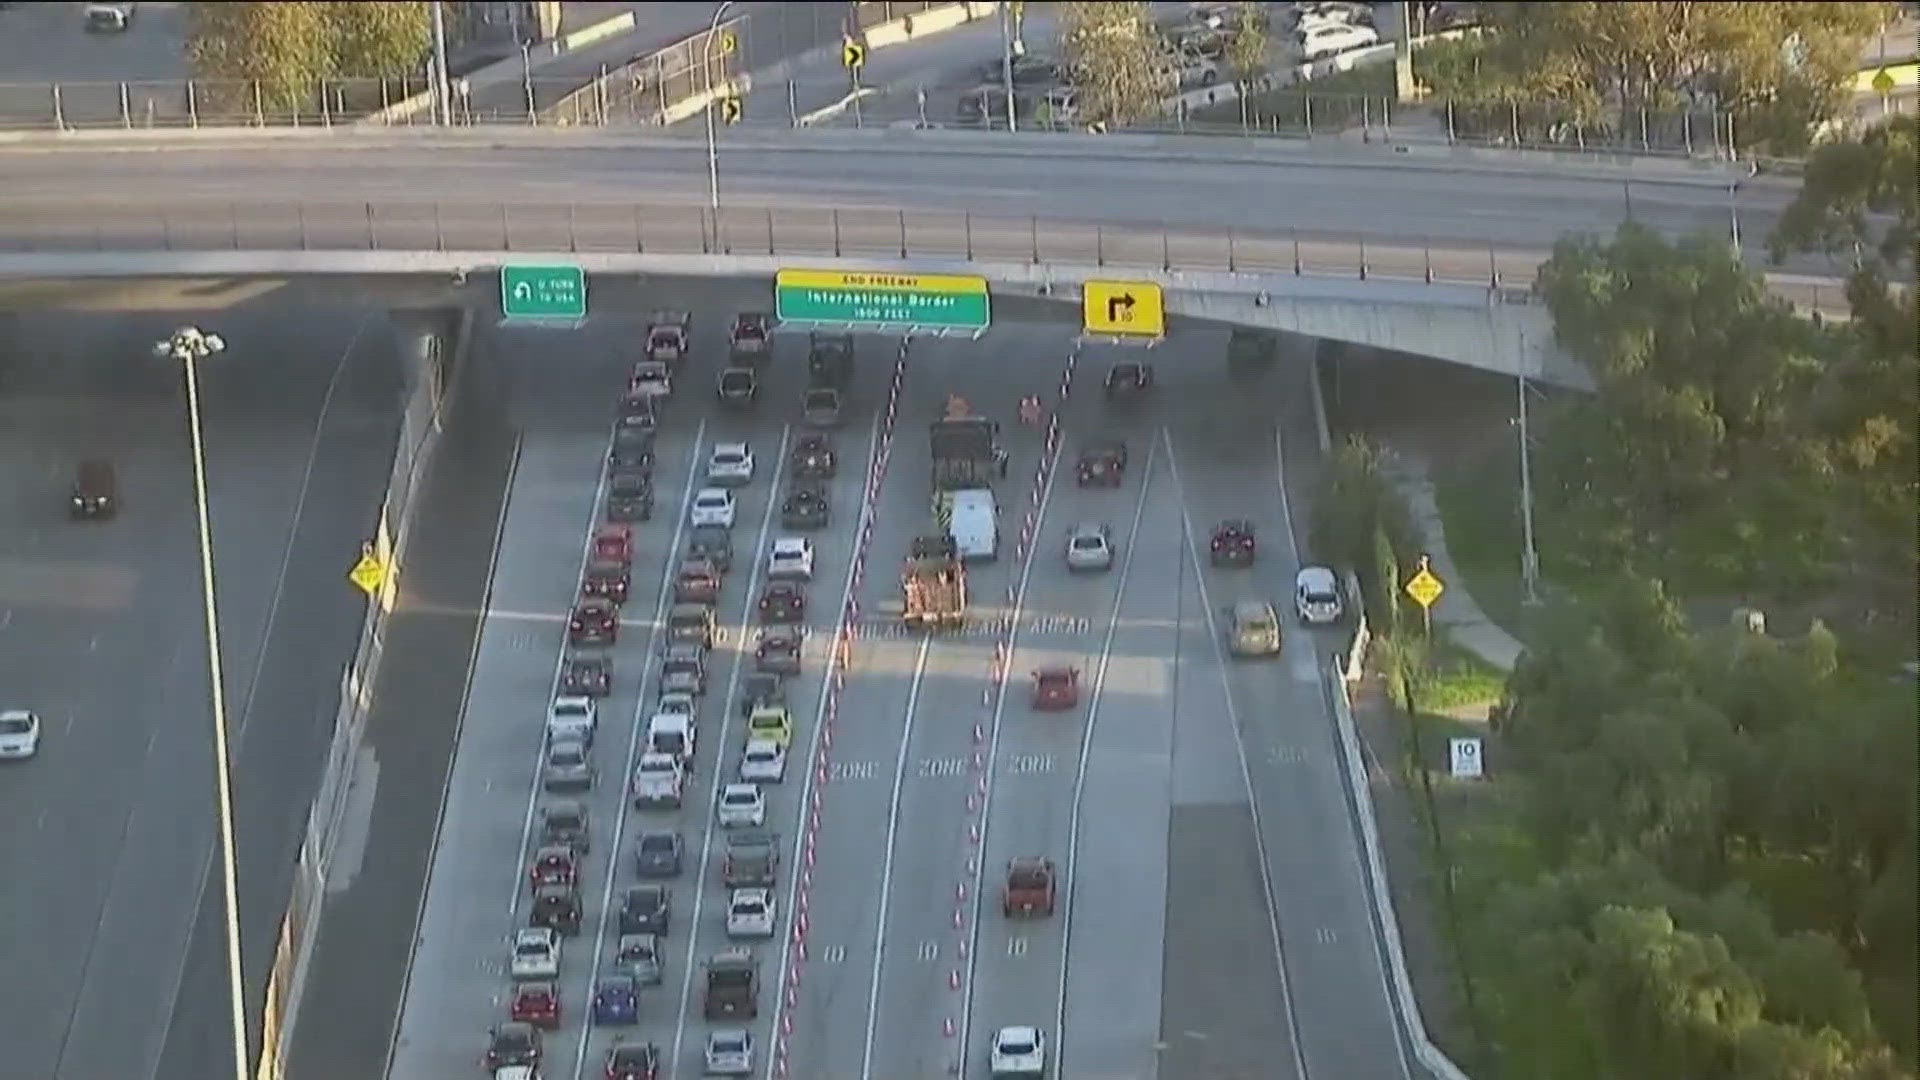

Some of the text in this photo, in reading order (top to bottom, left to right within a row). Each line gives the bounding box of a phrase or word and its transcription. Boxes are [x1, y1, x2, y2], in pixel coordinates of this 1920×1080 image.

[870, 276, 918, 287] FREEWAY
[807, 289, 955, 307] International Border
[1458, 743, 1475, 756] 10
